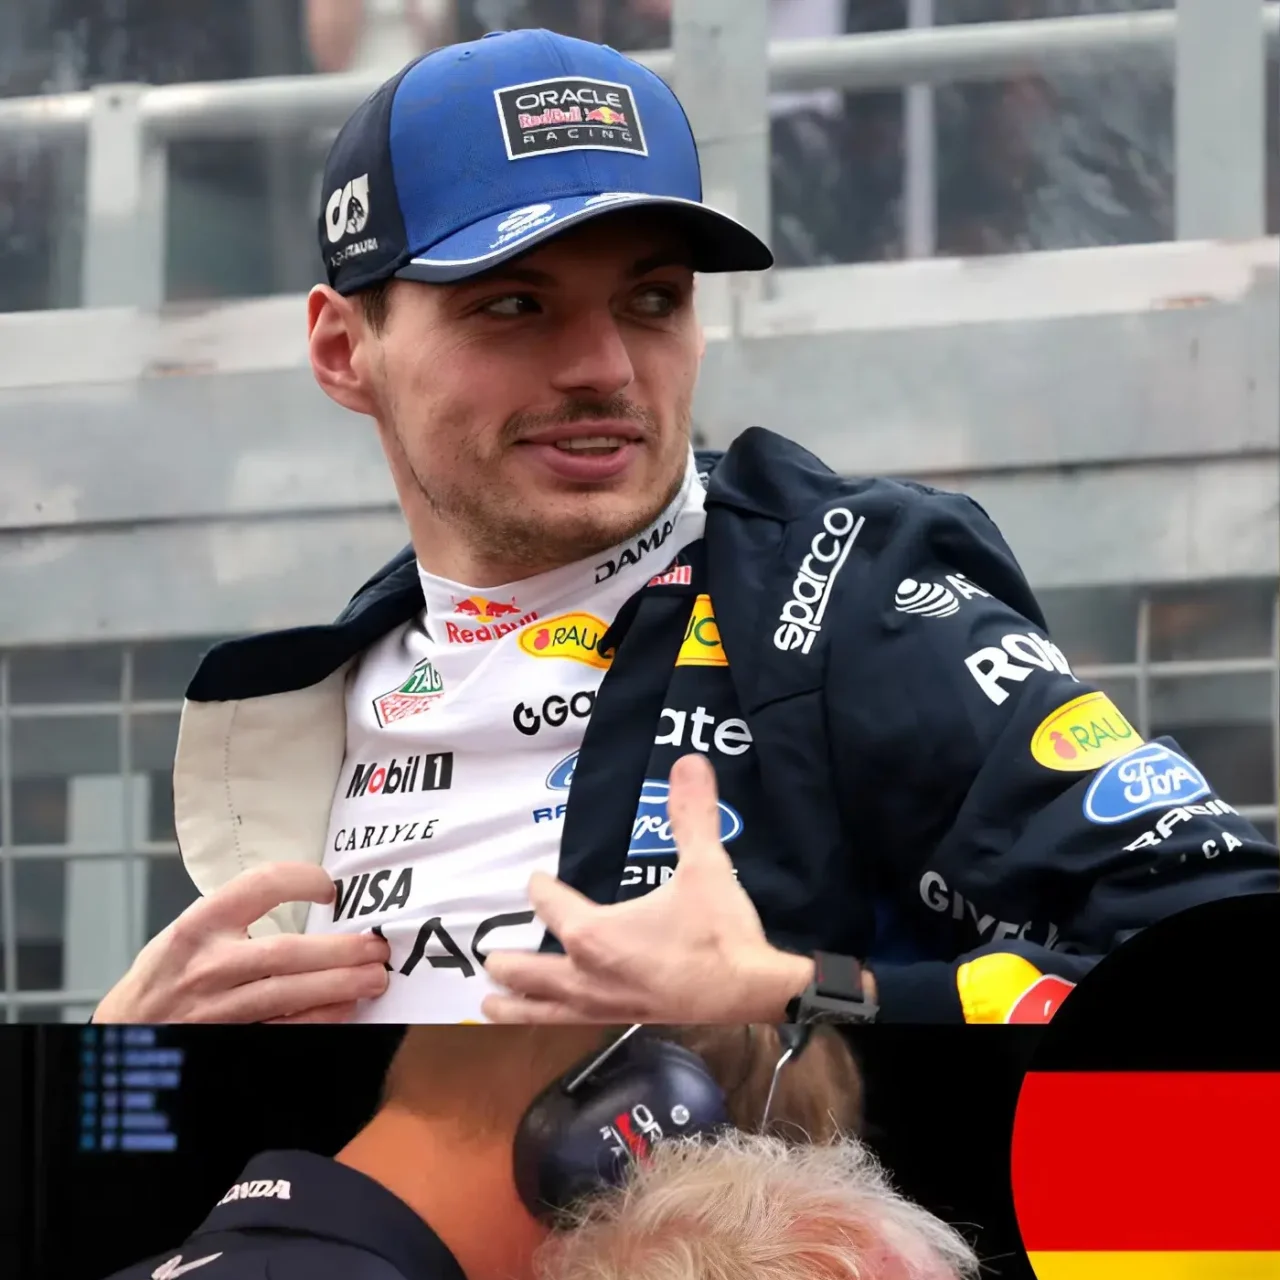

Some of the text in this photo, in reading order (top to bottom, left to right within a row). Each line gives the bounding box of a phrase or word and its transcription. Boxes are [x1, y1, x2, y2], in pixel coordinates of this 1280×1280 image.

[516, 89, 622, 110] ORACLE
[523, 129, 632, 144] RACING
[594, 519, 678, 584] DAMA
[773, 507, 853, 652] sparco
[446, 621, 490, 645] Red
[654, 705, 753, 755] ate
[1070, 714, 1132, 752] RAU
[345, 756, 416, 799] Mobil
[1122, 799, 1240, 851] RACIN
[332, 867, 413, 923] VISA
[216, 1179, 291, 1207] ONDA
